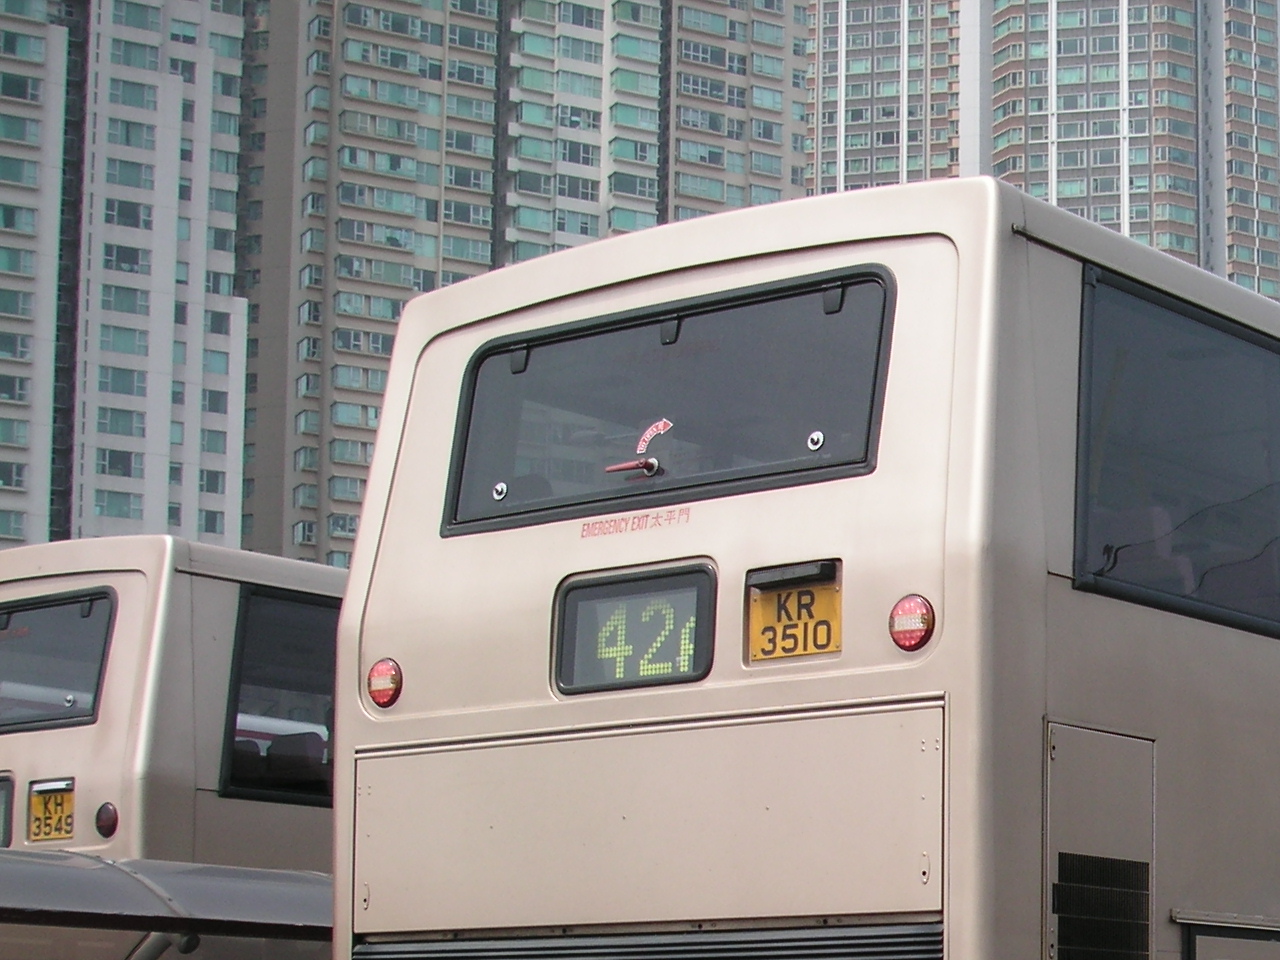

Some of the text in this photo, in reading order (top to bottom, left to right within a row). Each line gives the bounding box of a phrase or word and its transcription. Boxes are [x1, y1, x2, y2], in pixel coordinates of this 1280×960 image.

[581, 507, 690, 538] EMERGENCY EXIT 太平門
[777, 590, 815, 623] KR
[761, 620, 831, 656] 3510
[43, 794, 64, 815] KH
[32, 814, 73, 837] 3549
